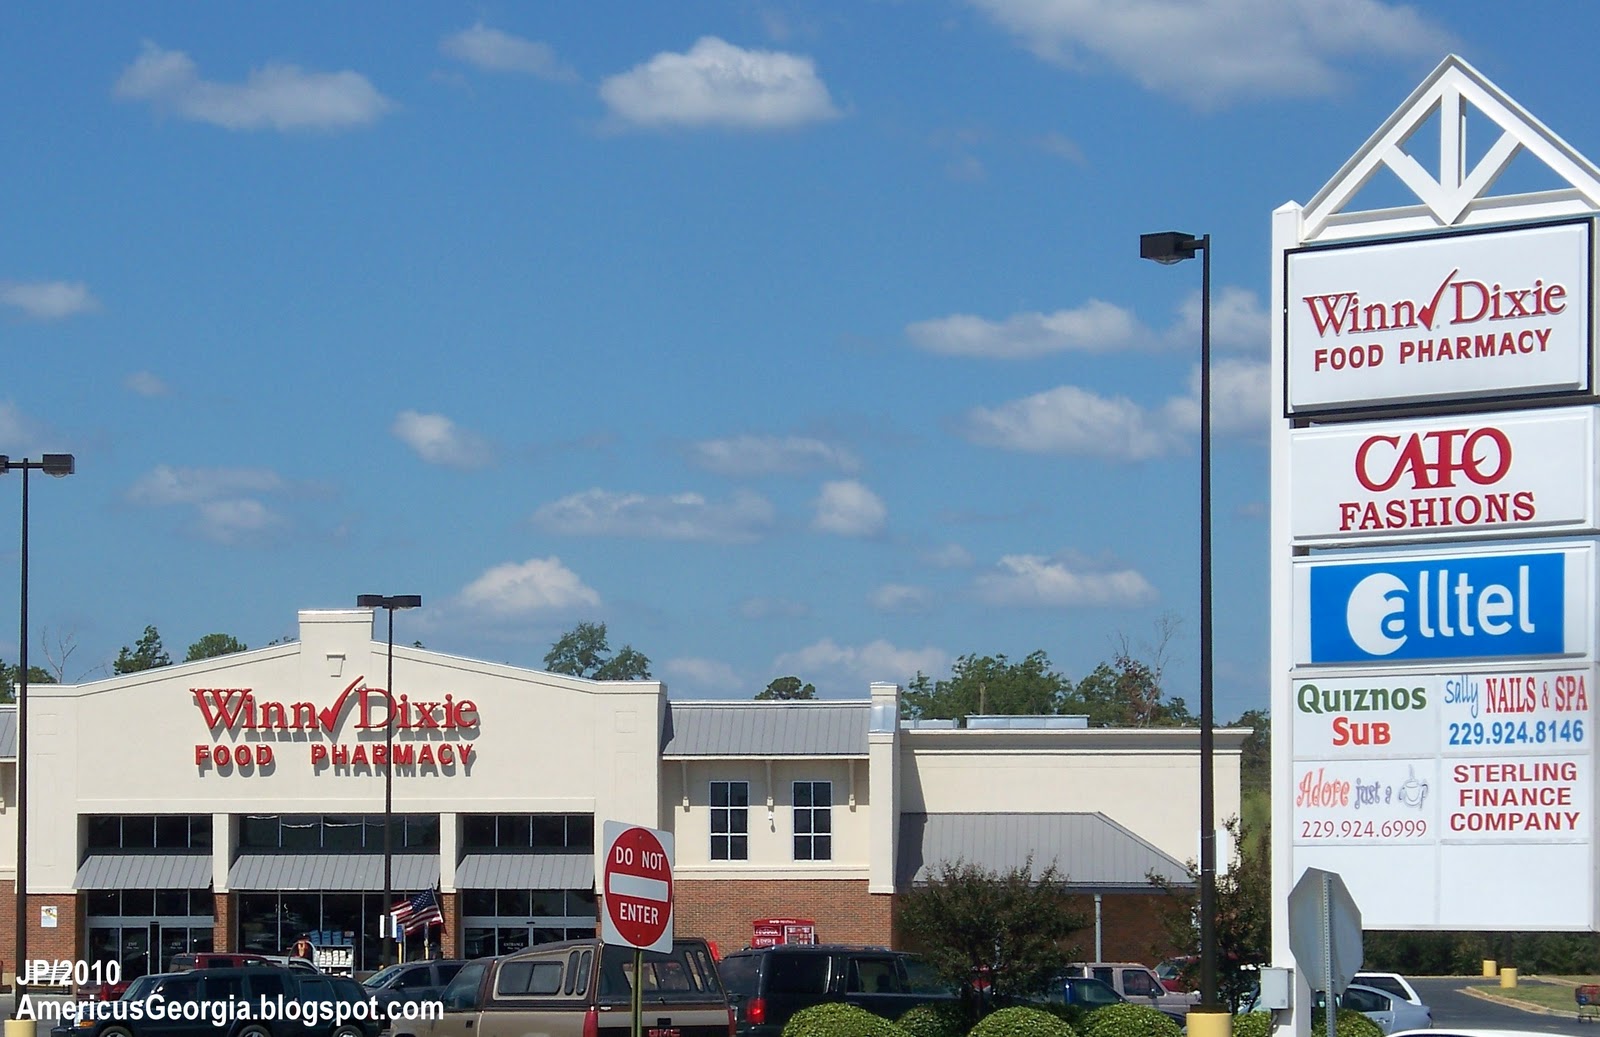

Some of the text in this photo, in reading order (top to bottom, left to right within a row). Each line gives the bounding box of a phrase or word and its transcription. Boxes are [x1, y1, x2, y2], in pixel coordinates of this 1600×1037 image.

[1302, 279, 1567, 338] Winn Dixie
[1314, 328, 1552, 372] FOOD PHARMACY
[1354, 426, 1513, 493] CATO
[1338, 491, 1536, 532] FASHIONS
[1346, 564, 1536, 656] alltel
[189, 687, 478, 730] Winn Dixie
[1485, 676, 1537, 714] NAILS
[1541, 680, 1550, 709] &
[1555, 675, 1589, 712] SPA
[1448, 719, 1584, 746] 229.924.8146
[195, 743, 474, 766] FOOD PHARMACY
[1296, 767, 1350, 808] Adore
[1354, 777, 1381, 810] just
[1384, 785, 1392, 805] a
[1453, 762, 1577, 784] STERLING
[1459, 787, 1572, 808] FINANCE
[1301, 819, 1427, 838] 229.924.6999
[1450, 811, 1580, 832] COMPANY
[615, 846, 664, 871] DO NOT
[620, 902, 659, 926] ENTER
